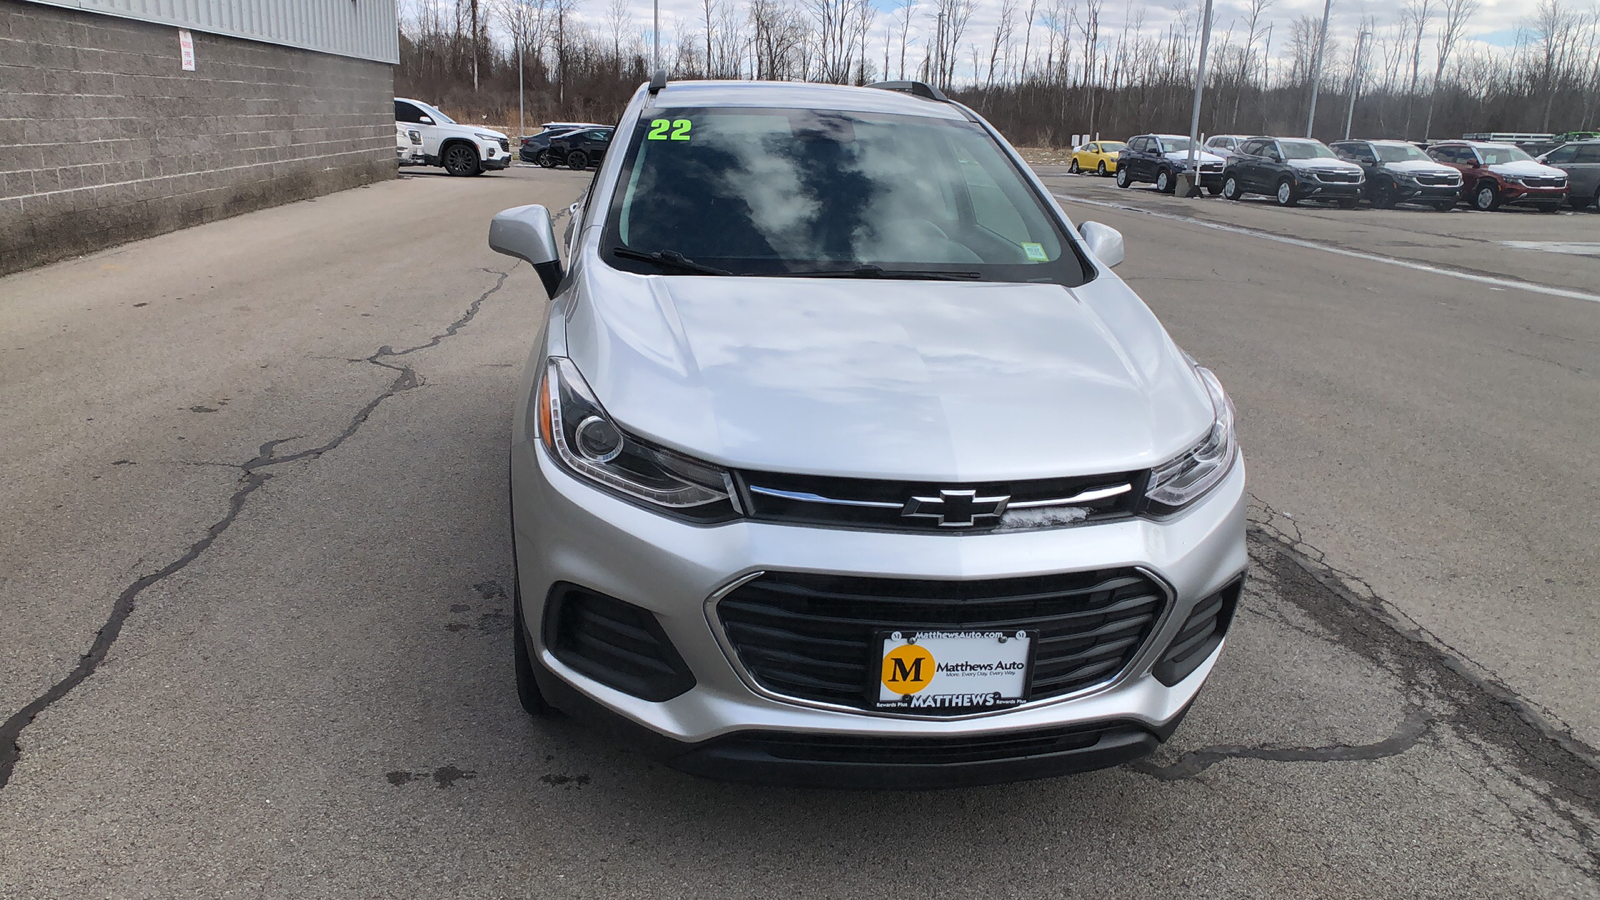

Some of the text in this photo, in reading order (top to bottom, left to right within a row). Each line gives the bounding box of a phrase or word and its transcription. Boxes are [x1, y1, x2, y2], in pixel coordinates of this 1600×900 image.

[647, 118, 692, 141] 22
[915, 631, 1003, 639] MatthewsAuto.com
[887, 657, 926, 682] M
[936, 660, 1025, 673] Matthews Auto
[910, 693, 995, 708] MATTHEWS
